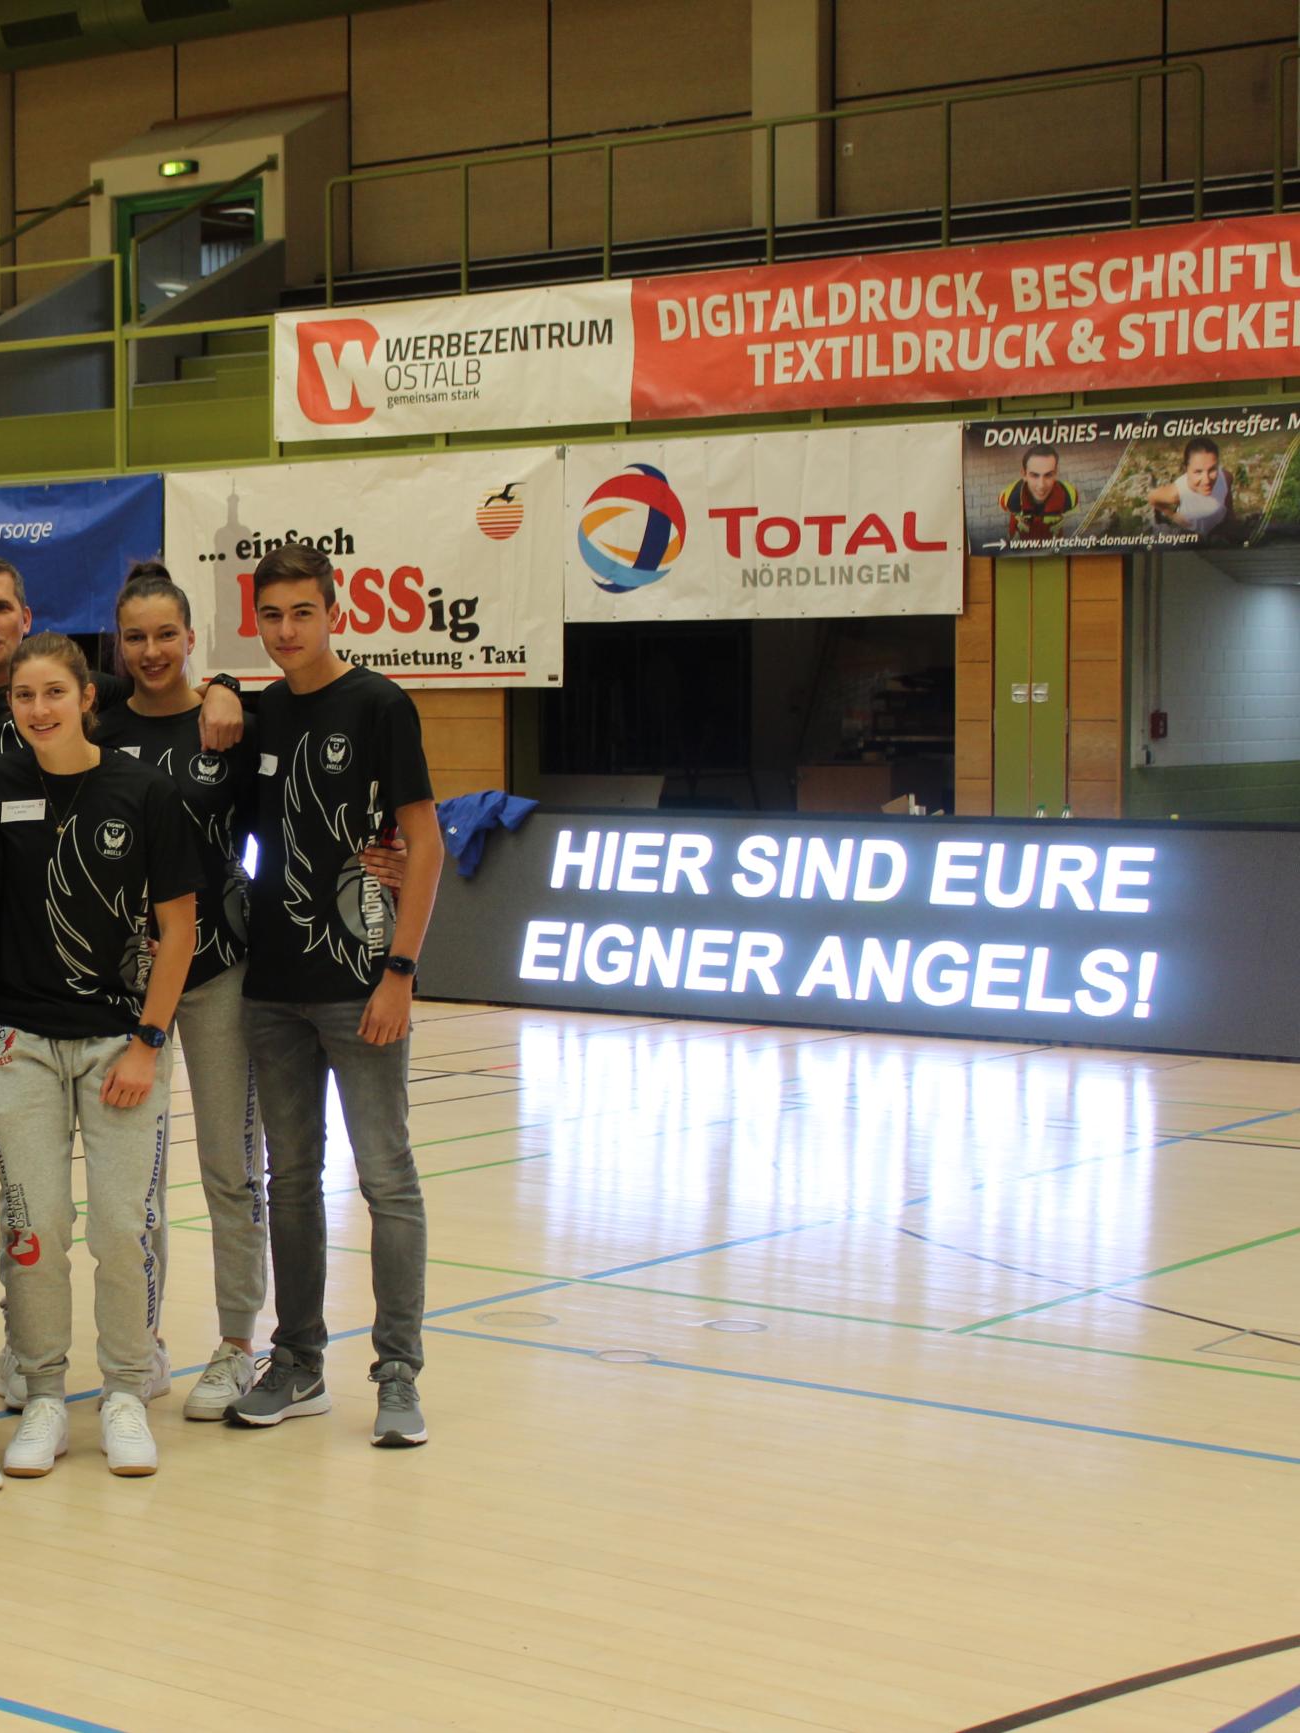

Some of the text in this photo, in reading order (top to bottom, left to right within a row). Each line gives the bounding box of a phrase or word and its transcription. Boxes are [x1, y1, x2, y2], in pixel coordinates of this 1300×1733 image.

[657, 271, 999, 342] DIGITALDRUCK,
[385, 318, 613, 362] WERBEZENTRUM
[746, 321, 1059, 386] TEXTILDRUCK
[1067, 317, 1106, 364] &
[384, 358, 481, 392] OSTALB
[386, 387, 480, 409] gemeinsam stark
[984, 423, 1098, 448] DONAURIES
[1114, 419, 1157, 440] Mein
[1163, 413, 1281, 438] Glückstreffer.
[708, 506, 948, 559] TOTAL
[741, 563, 911, 588] NÖRDLINGEN
[480, 645, 526, 664] Taxi
[549, 830, 1156, 914] HIER SIND EURE
[367, 928, 385, 959] THG
[518, 920, 1158, 1019] EIGNER ANGELS!
